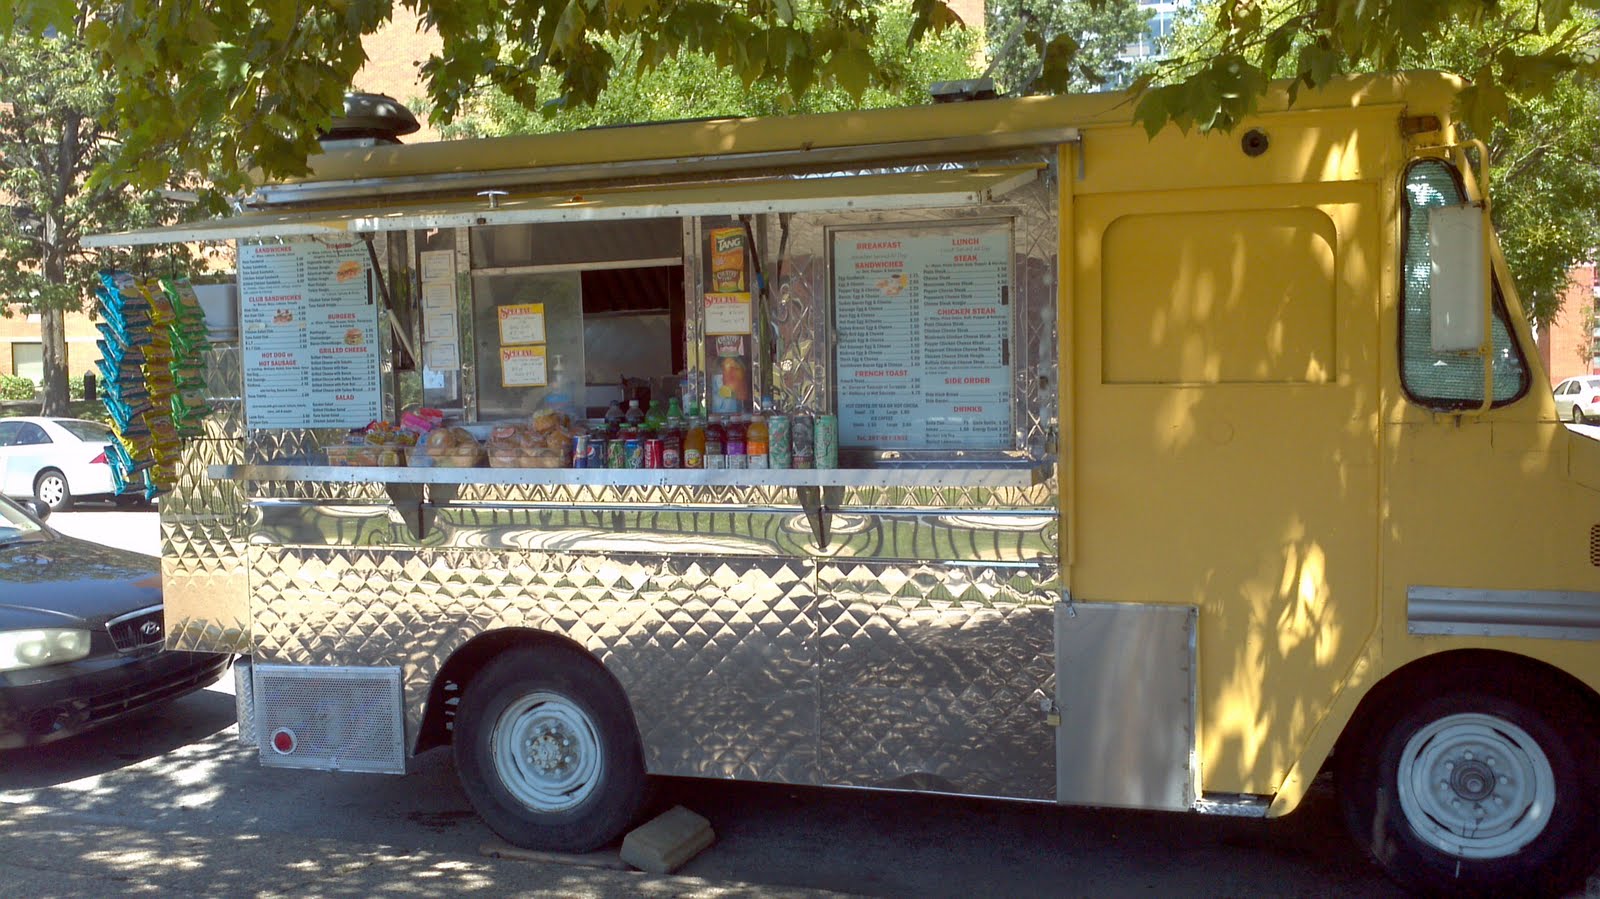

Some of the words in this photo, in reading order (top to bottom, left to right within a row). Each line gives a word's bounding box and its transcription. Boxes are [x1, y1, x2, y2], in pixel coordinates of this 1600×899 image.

[717, 237, 740, 251] TANG
[856, 242, 902, 250] BREAKFAST
[952, 238, 979, 246] LUNCH
[255, 246, 291, 254] SANDWICHES
[855, 261, 904, 269] SANDWICHES
[944, 377, 962, 385] SIDE
